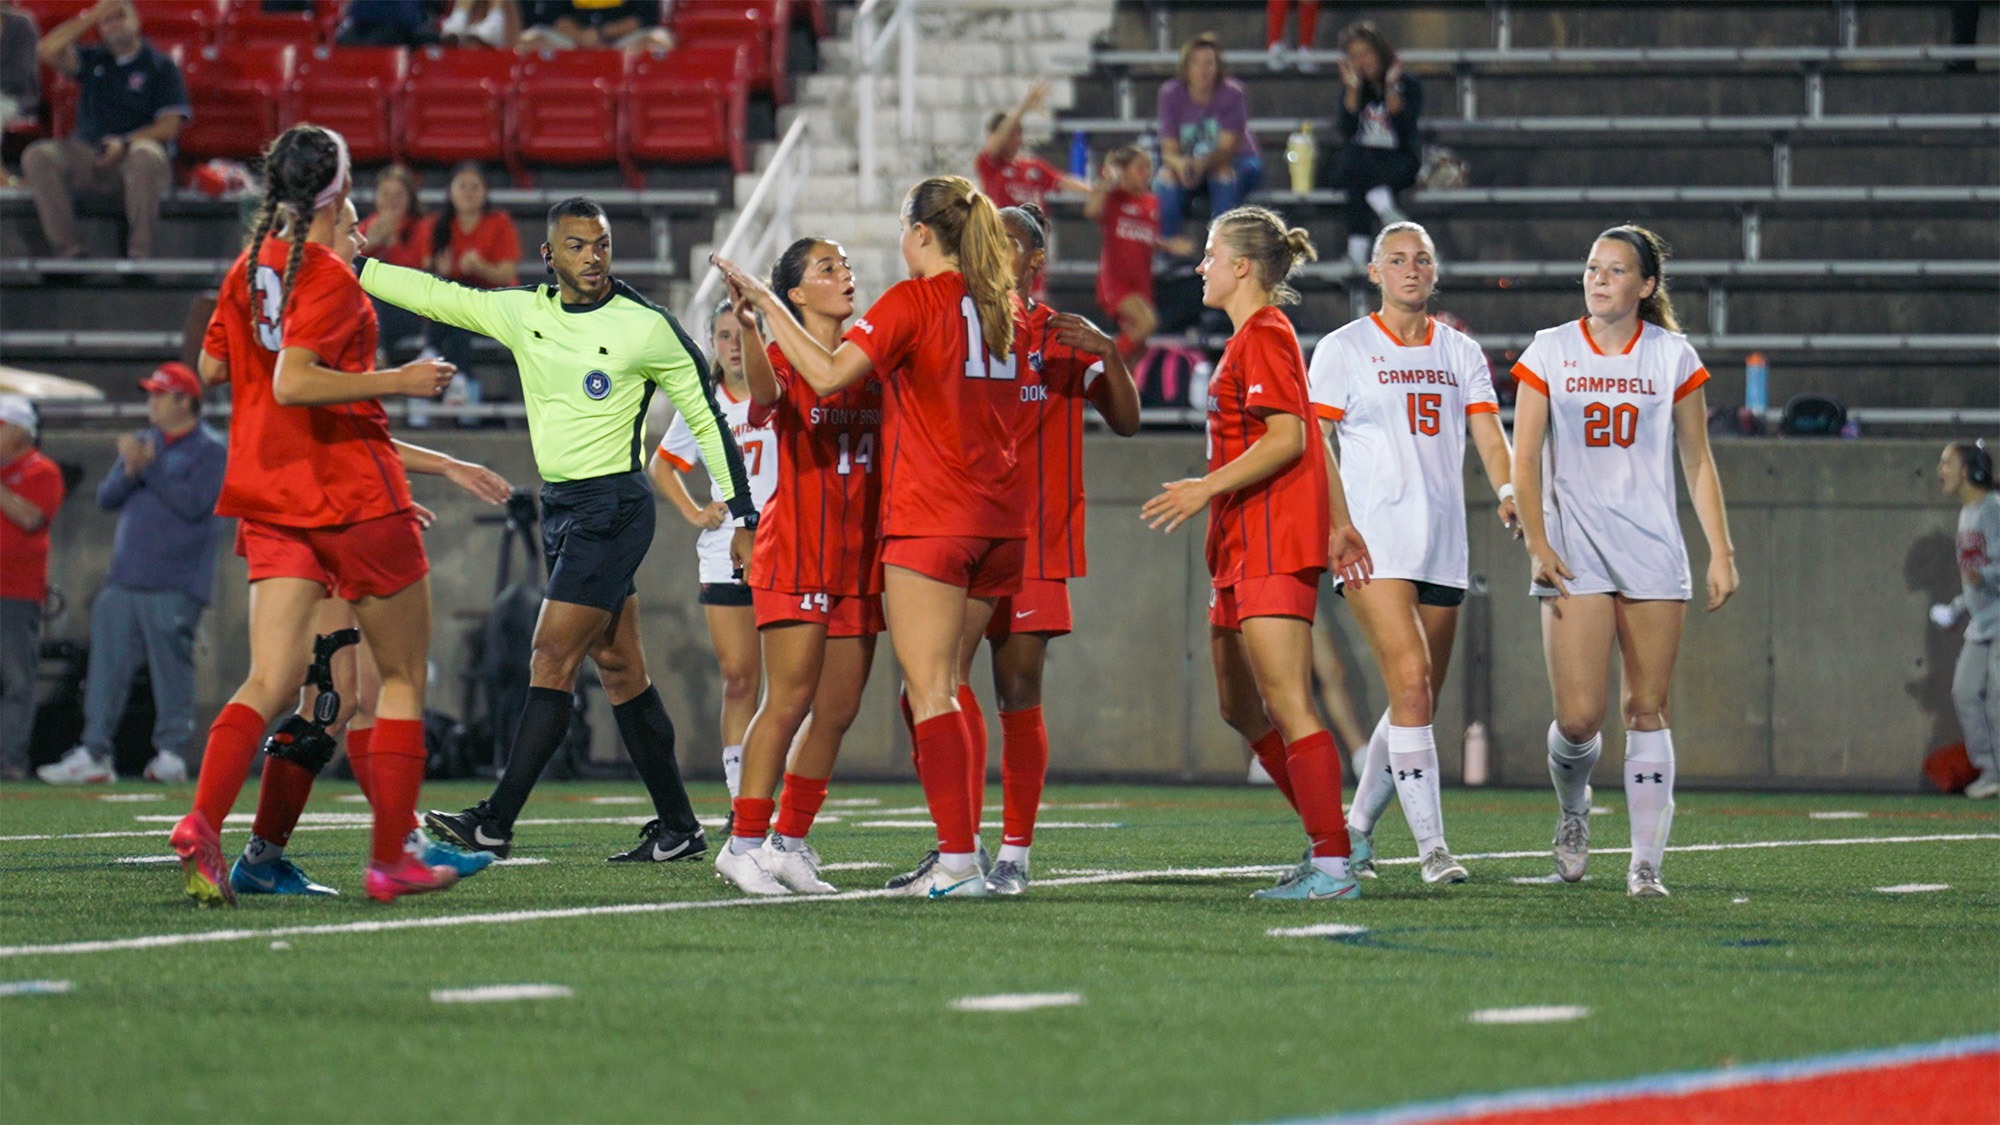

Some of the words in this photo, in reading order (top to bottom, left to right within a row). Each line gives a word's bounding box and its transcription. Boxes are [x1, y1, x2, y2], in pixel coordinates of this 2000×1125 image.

[255, 265, 282, 351] 3
[1378, 369, 1459, 388] CAMPBELL
[1565, 376, 1657, 396] CAMPBELL
[810, 407, 858, 425] STONY
[859, 408, 882, 425] BRO
[1406, 392, 1442, 437] 15
[1583, 401, 1640, 449] 20
[836, 432, 874, 475] 14
[800, 592, 829, 614] 14
